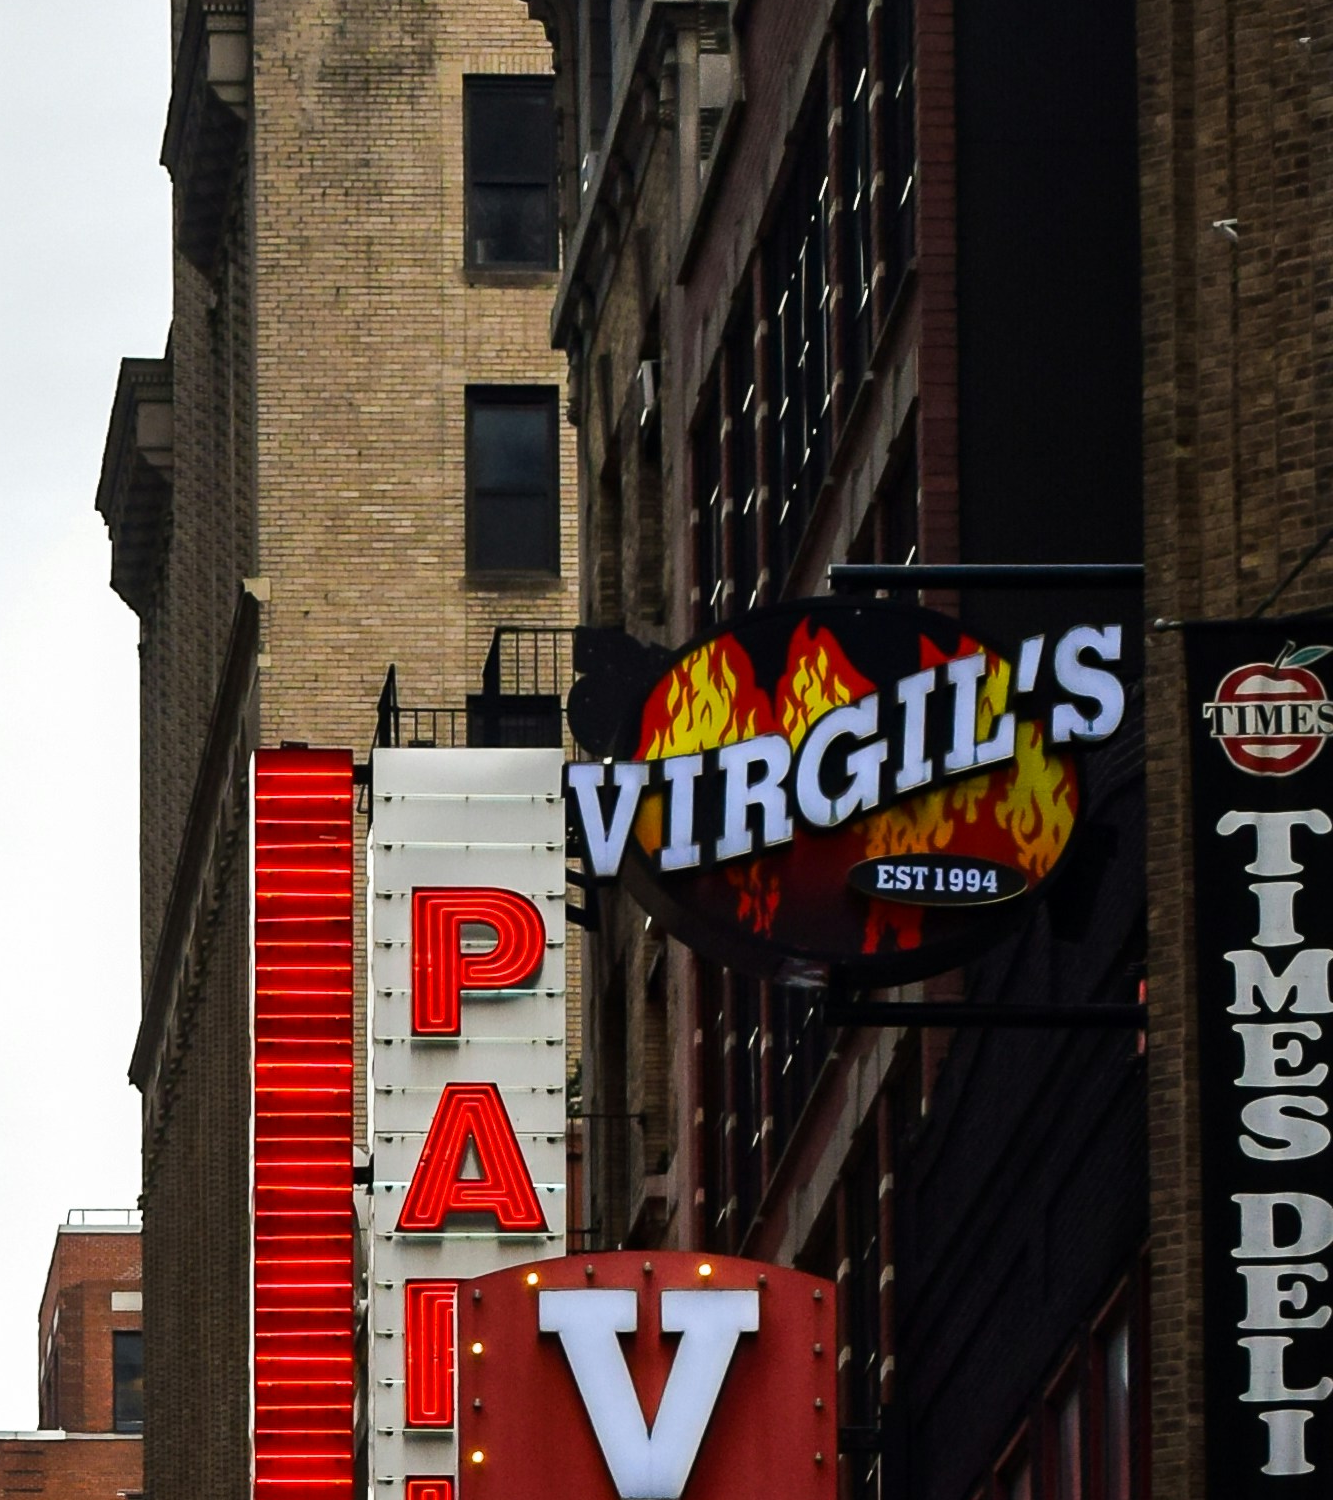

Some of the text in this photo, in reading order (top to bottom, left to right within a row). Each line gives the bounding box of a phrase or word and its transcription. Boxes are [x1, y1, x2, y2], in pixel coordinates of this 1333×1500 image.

[568, 624, 1124, 877] VIRGIL'S
[876, 865, 998, 895] EST 1994
[1215, 809, 1333, 1161] TIMES
[1230, 1192, 1333, 1476] DELI
